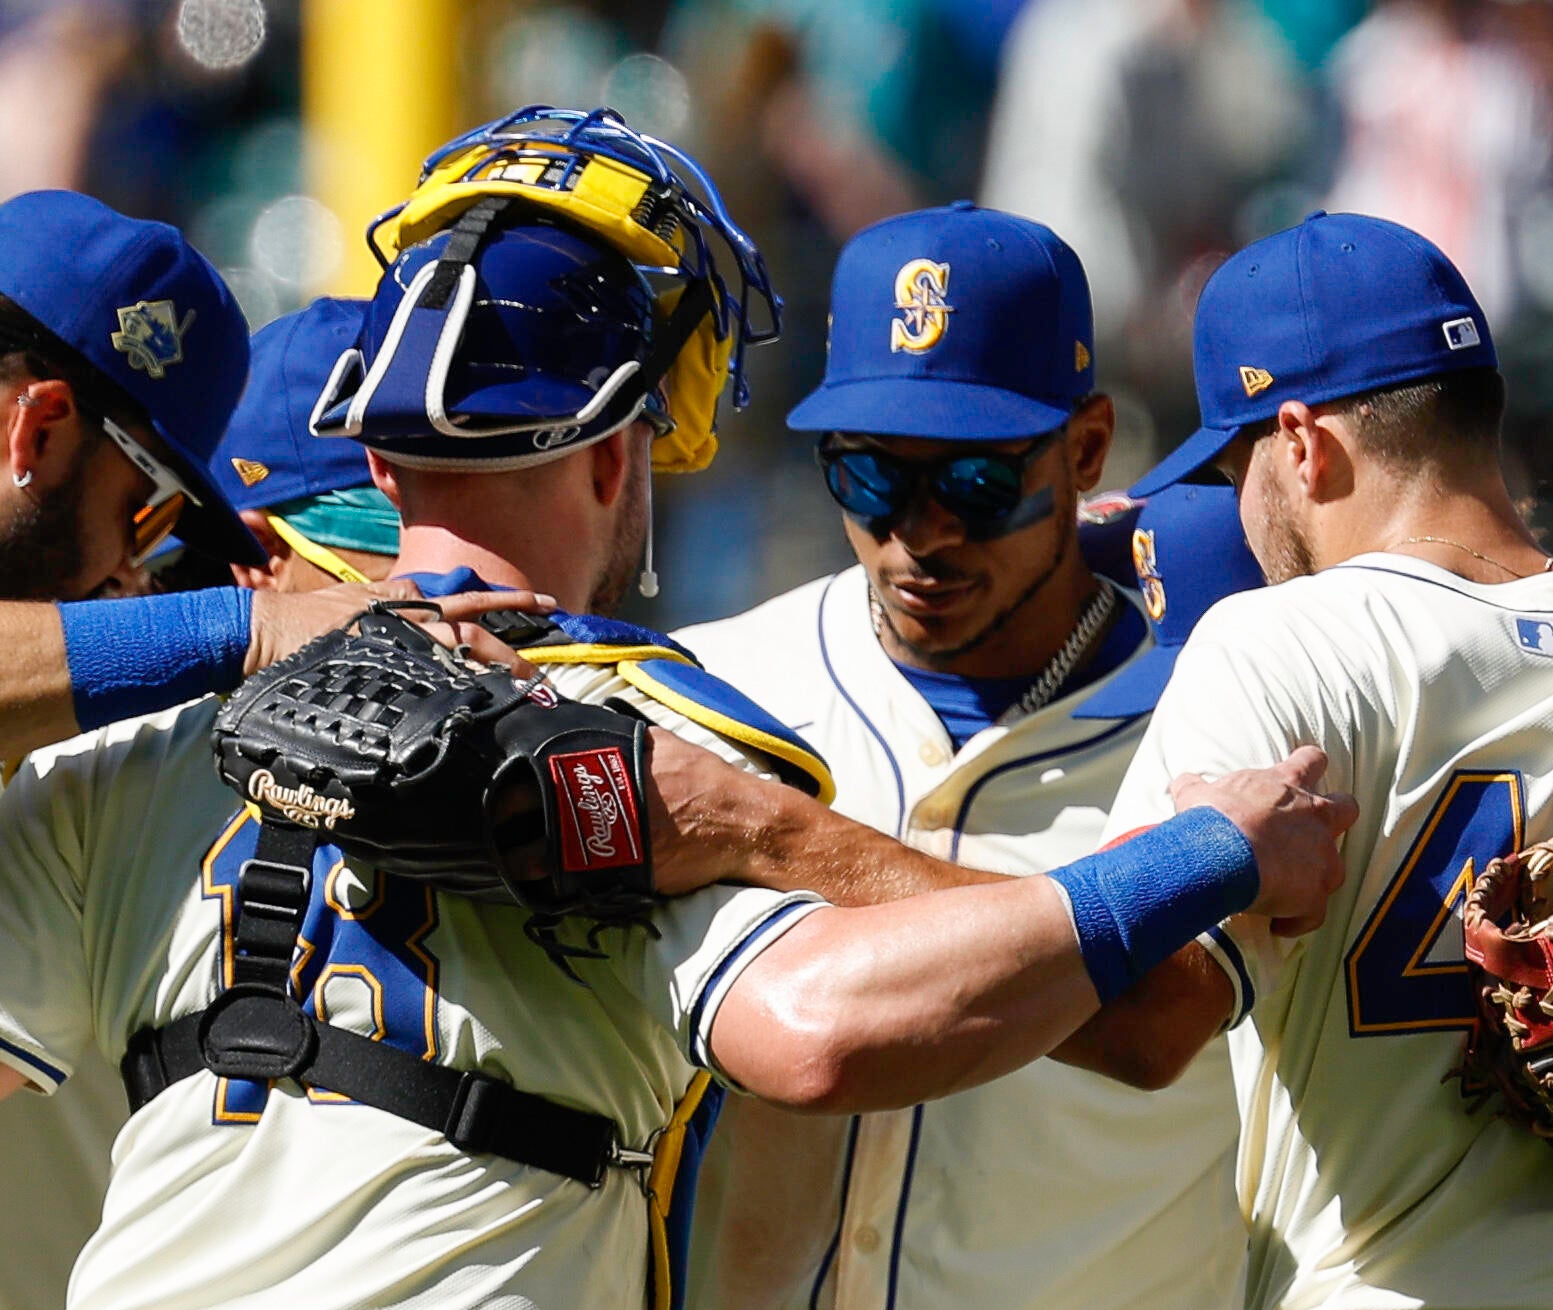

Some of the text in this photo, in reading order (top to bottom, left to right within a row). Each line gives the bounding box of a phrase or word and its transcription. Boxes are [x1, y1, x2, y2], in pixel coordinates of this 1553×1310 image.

[891, 258, 954, 355] S
[248, 768, 355, 830] Rawlings
[573, 763, 616, 857] Rawlings
